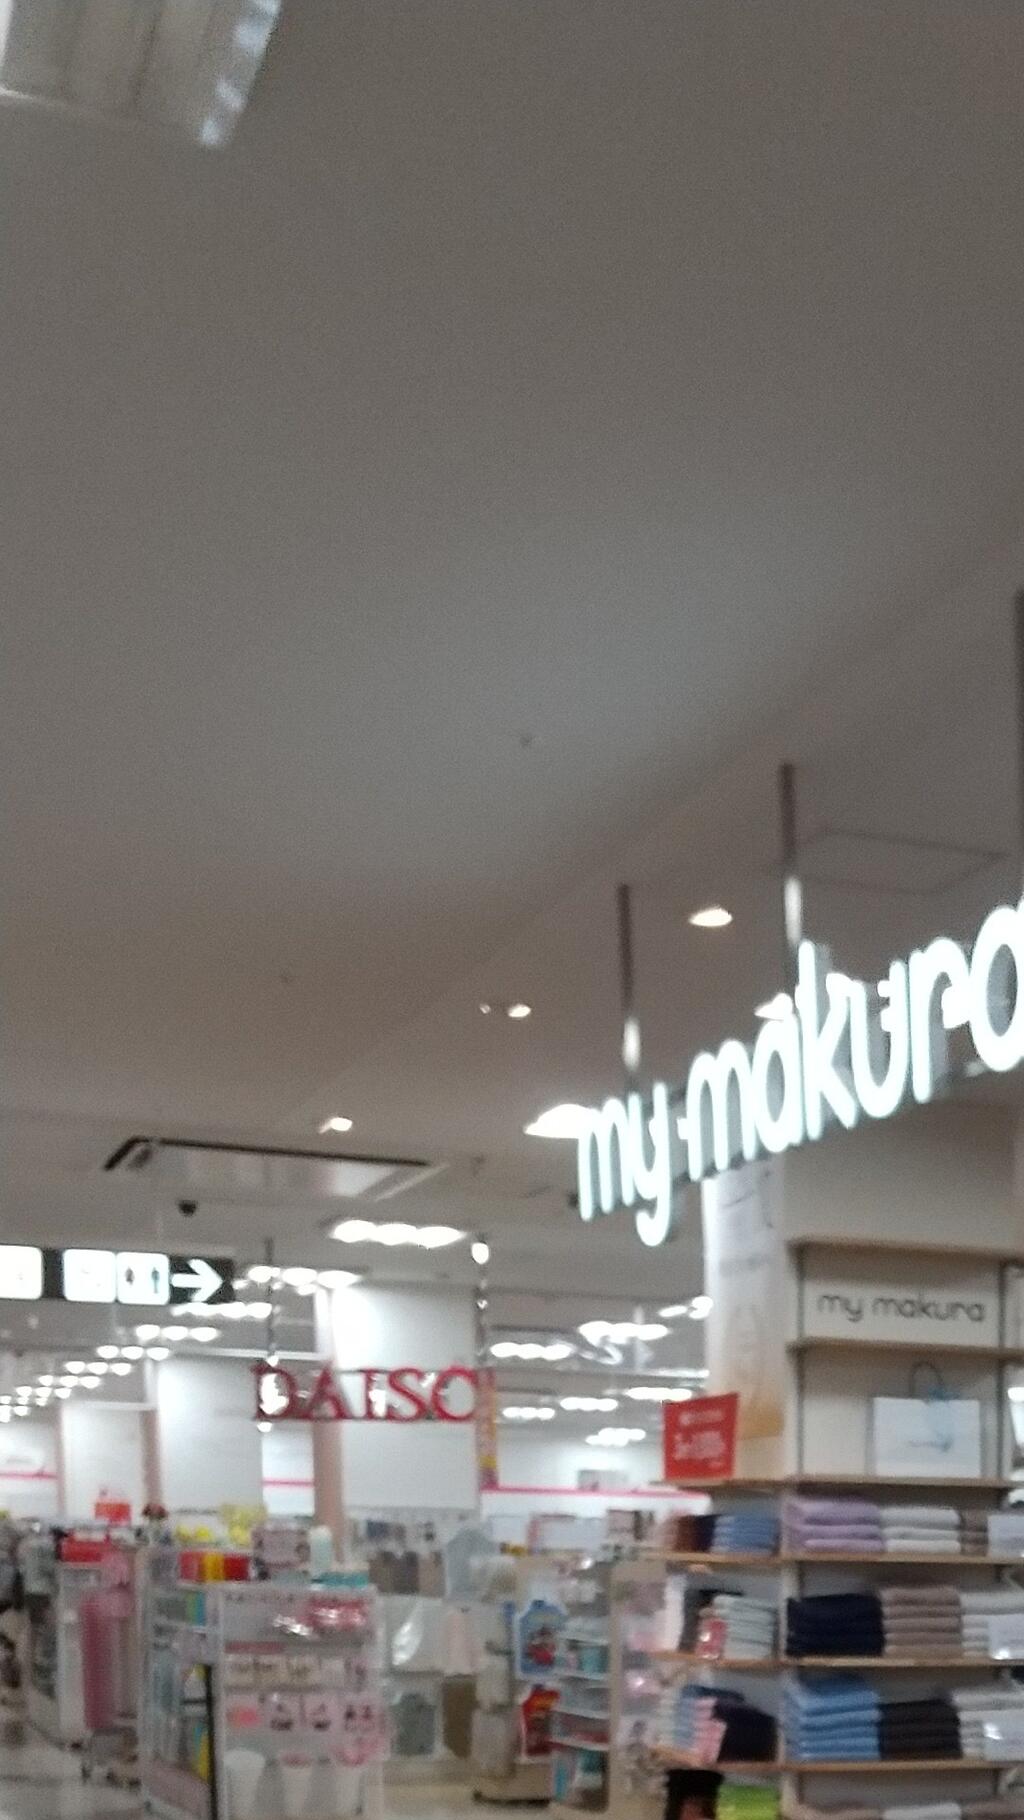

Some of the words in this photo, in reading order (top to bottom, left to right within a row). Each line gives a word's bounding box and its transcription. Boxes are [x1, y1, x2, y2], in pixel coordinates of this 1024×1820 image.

[578, 1082, 672, 1247] my
[817, 1294, 863, 1322] my
[871, 1292, 985, 1322] makura
[252, 1362, 481, 1421] DAISO
